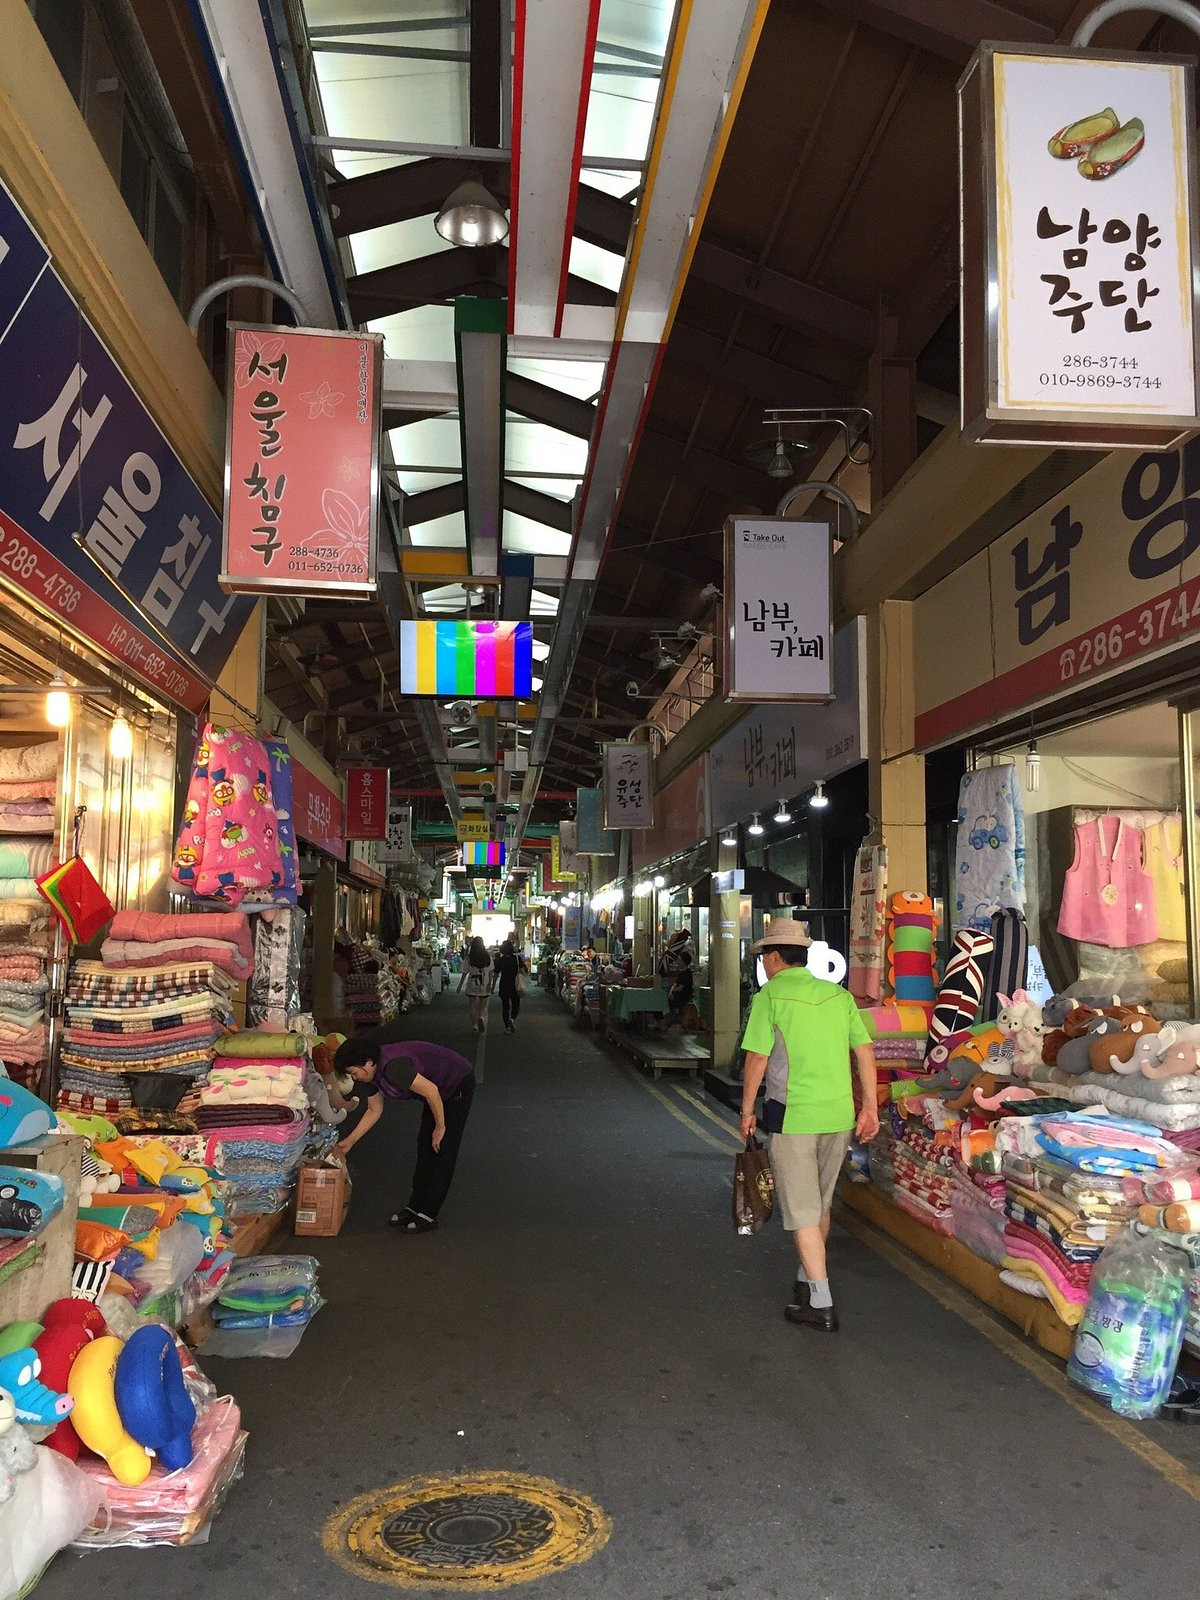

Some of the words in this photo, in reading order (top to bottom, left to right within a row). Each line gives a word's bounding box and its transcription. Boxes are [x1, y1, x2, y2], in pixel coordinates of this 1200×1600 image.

[1036, 205, 1160, 272] 남양
[1040, 274, 1160, 334] 주단
[1062, 354, 1139, 370] 286-3744
[1039, 372, 1162, 390] 010-9869-3744
[243, 351, 289, 567] 서울침구
[13, 362, 237, 655] 서울침구
[289, 546, 339, 559] 288-4736
[752, 532, 770, 542] Take
[771, 533, 785, 543] Out
[1, 538, 81, 613] 288-4736
[288, 560, 364, 575] 011-652-0736
[743, 599, 798, 634] 남부,
[770, 635, 824, 660] 카페
[360, 772, 374, 825] 홈스마일
